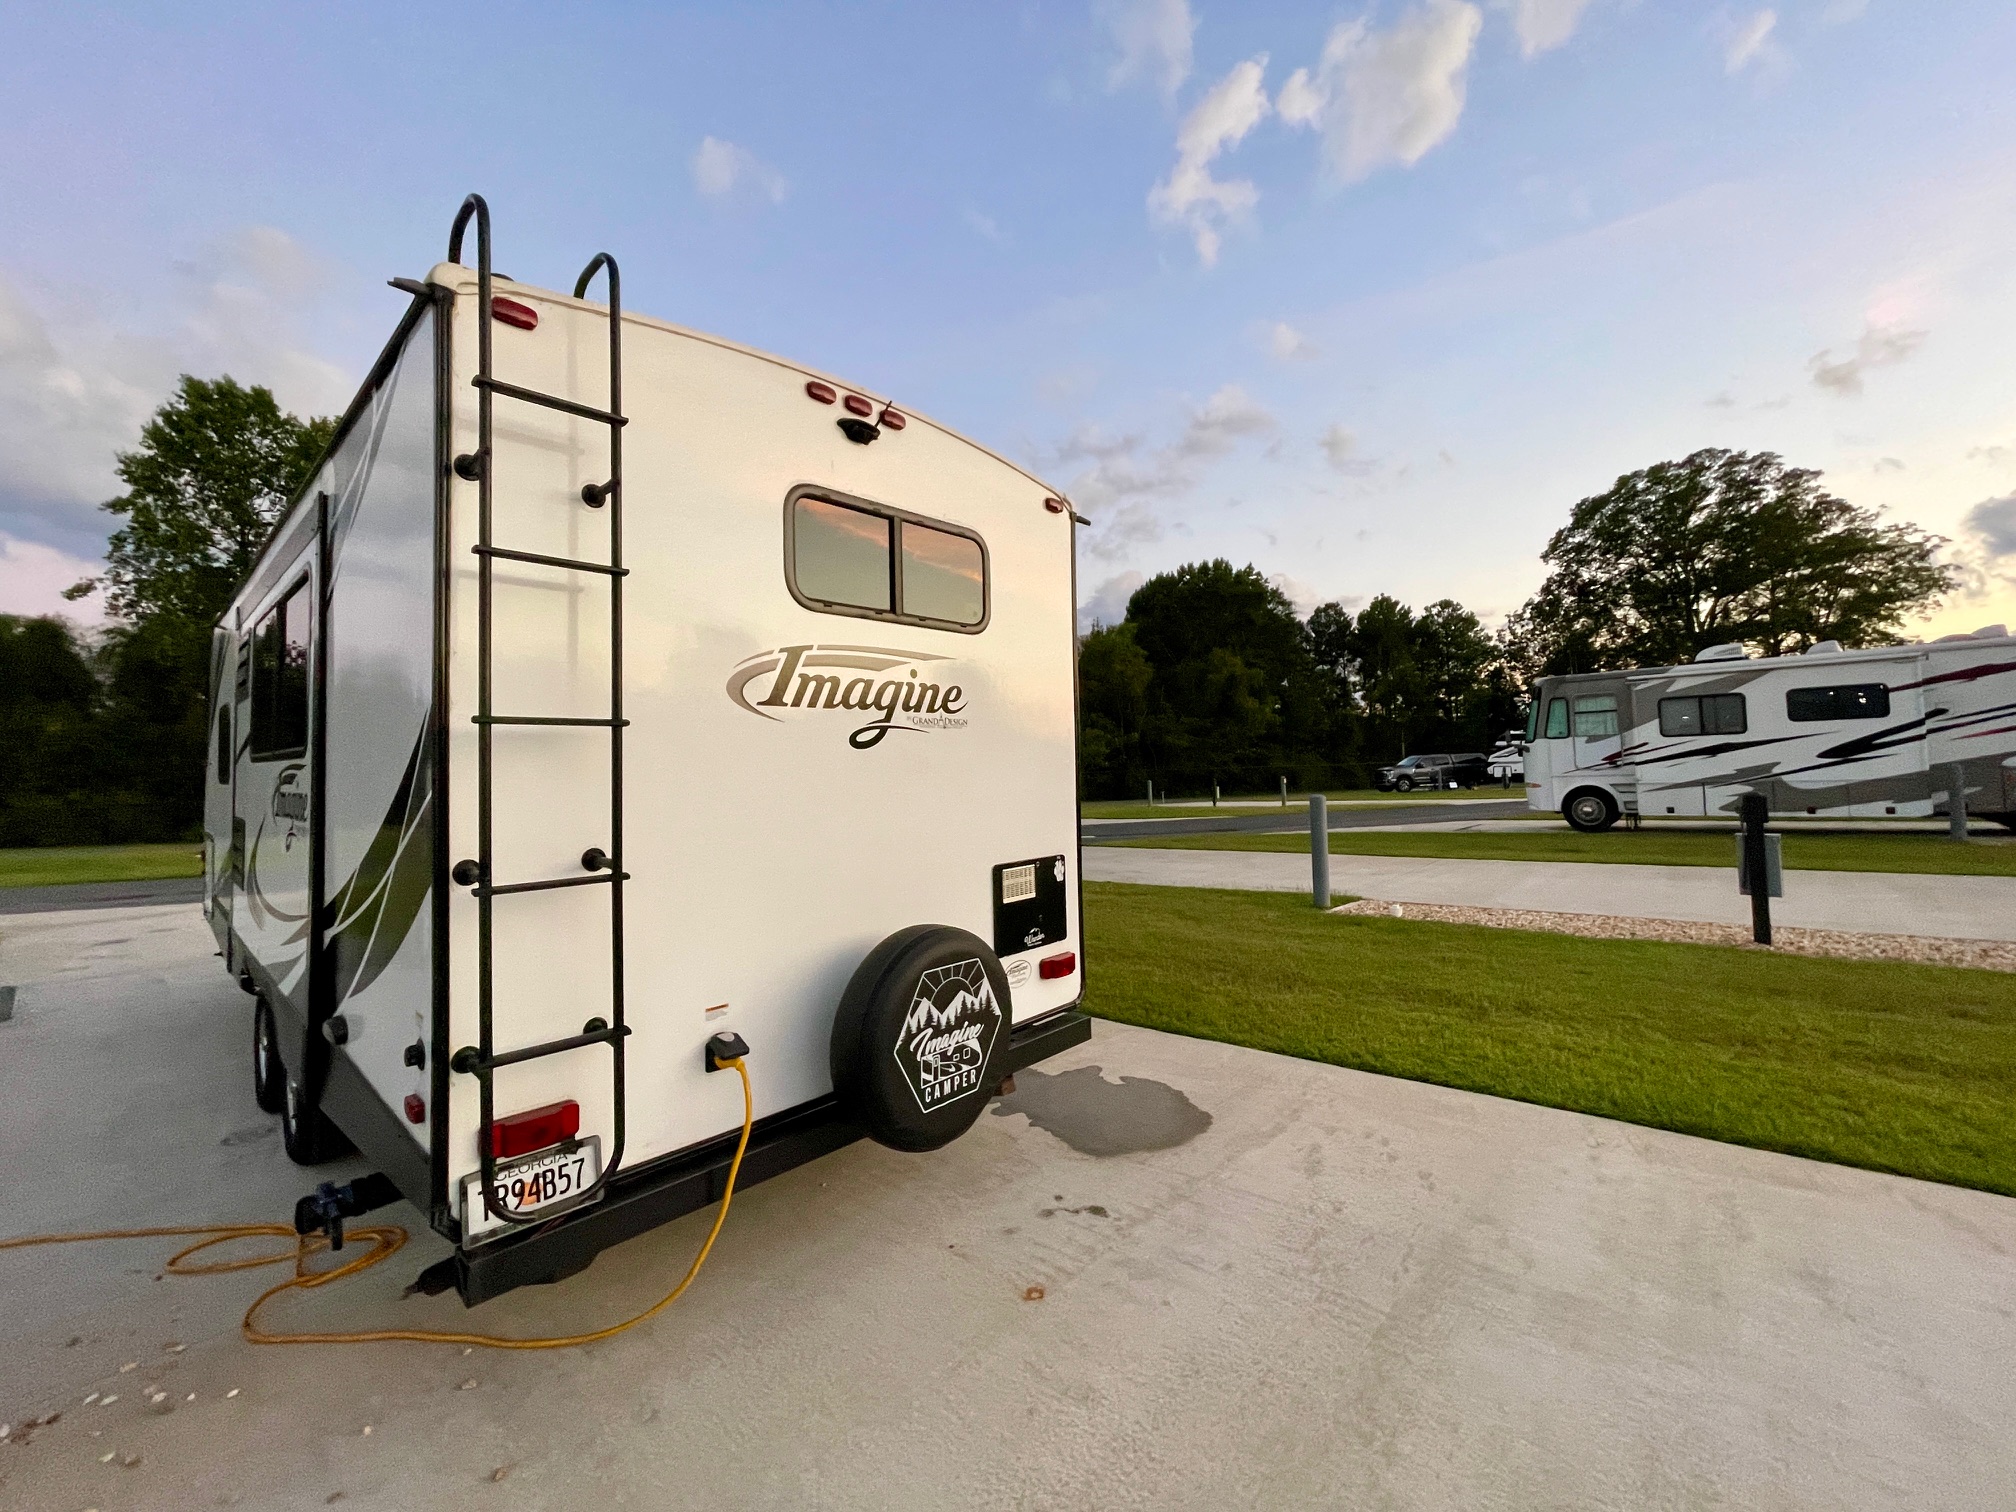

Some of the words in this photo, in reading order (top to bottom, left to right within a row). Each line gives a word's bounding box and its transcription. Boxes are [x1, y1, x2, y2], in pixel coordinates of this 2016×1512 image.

[756, 645, 969, 750] Imagine
[909, 1021, 985, 1062] Imagine
[925, 1069, 977, 1103] CAMPER
